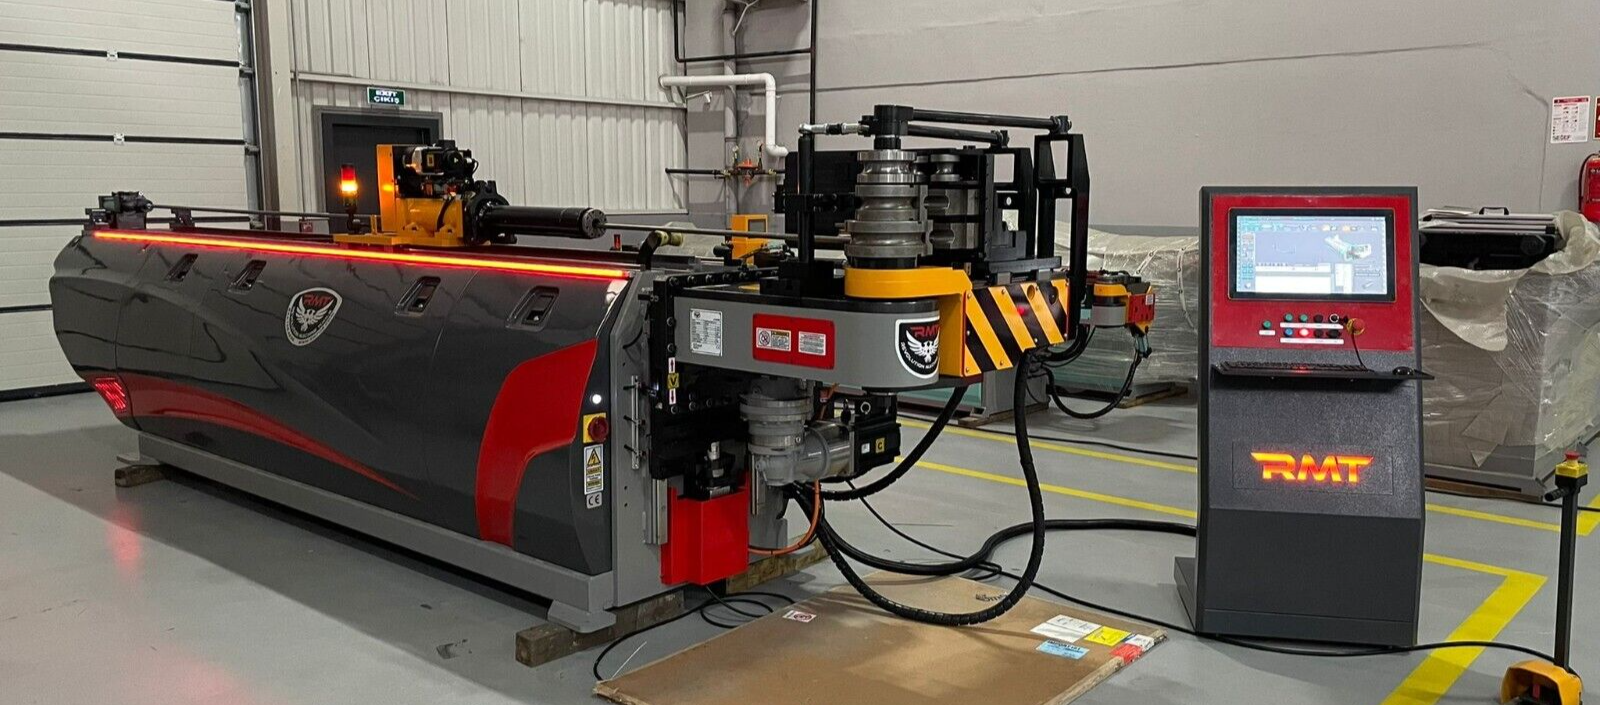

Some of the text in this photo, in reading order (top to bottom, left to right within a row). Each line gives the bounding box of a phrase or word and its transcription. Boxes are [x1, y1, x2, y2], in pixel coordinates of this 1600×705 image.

[302, 293, 333, 306] RMT
[669, 377, 678, 385] V
[1250, 452, 1374, 484] RMT
[588, 494, 600, 506] CE
